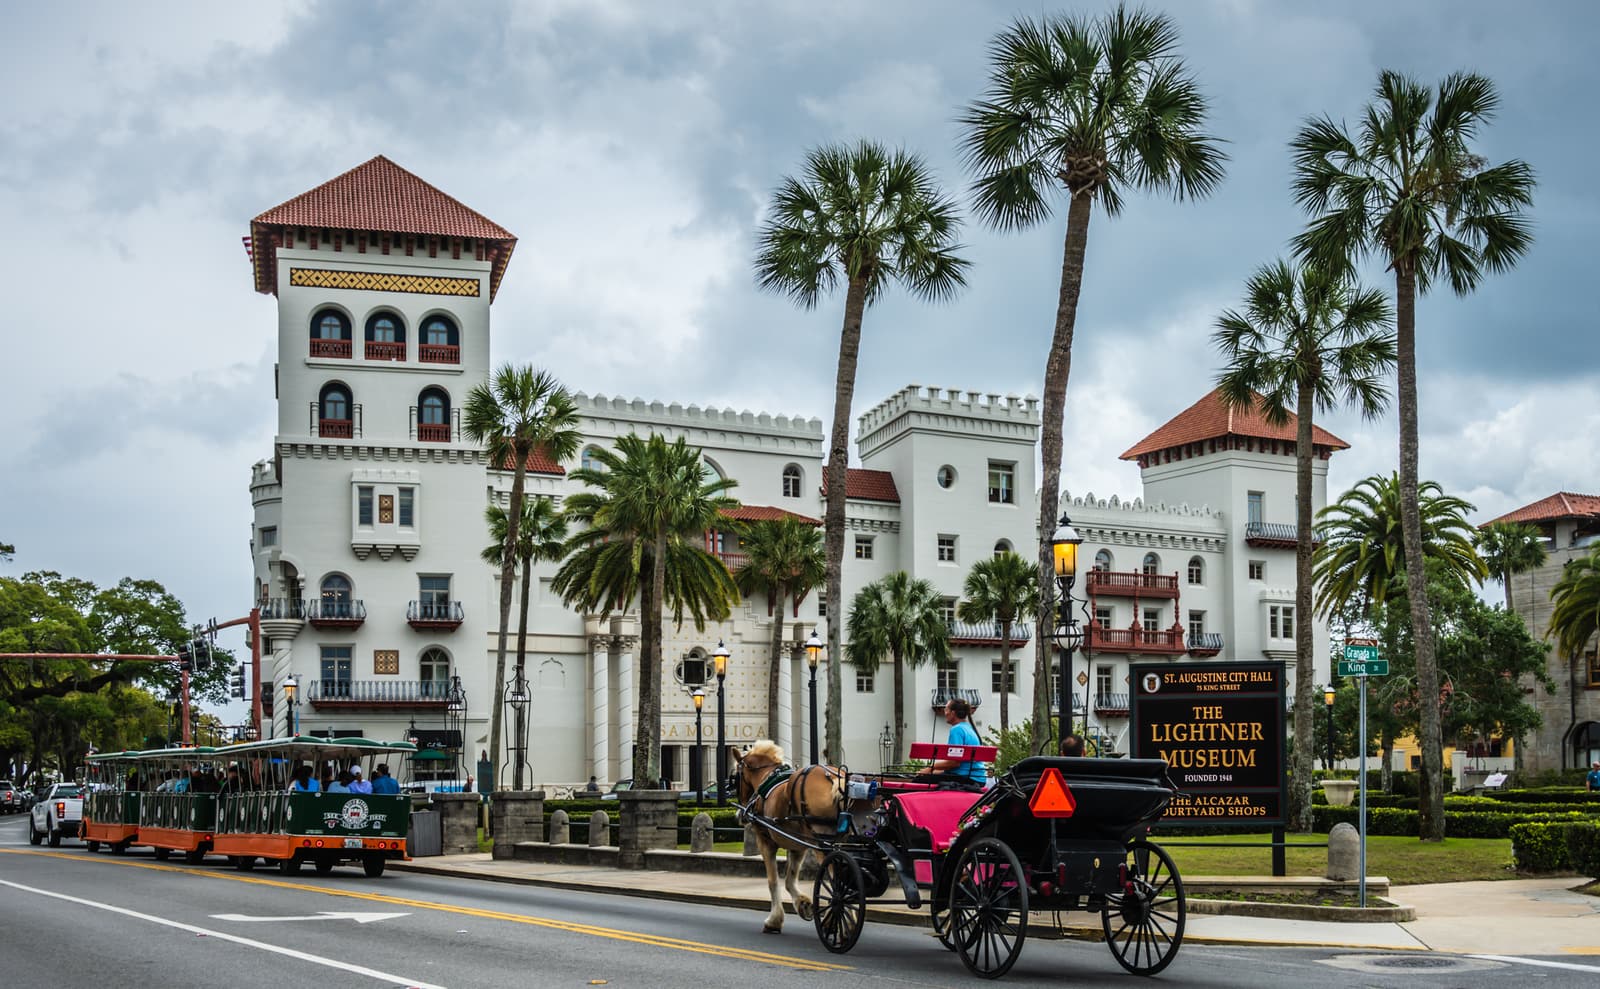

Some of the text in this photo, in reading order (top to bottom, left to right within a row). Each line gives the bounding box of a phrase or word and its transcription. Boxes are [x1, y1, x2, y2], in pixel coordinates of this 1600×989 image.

[1346, 647, 1370, 659] Granada
[1347, 662, 1366, 674] King
[1164, 671, 1273, 683] ST. AUGUSTINE CITY HALL
[1192, 706, 1223, 720] THE
[1151, 722, 1265, 742] LIGHTNER
[1160, 748, 1257, 768] MUSEUM
[1184, 774, 1233, 782] FOUNDED 1948
[1169, 796, 1250, 806] THE ALCAZAR
[1162, 806, 1267, 816] OURTYARD SHOPS
